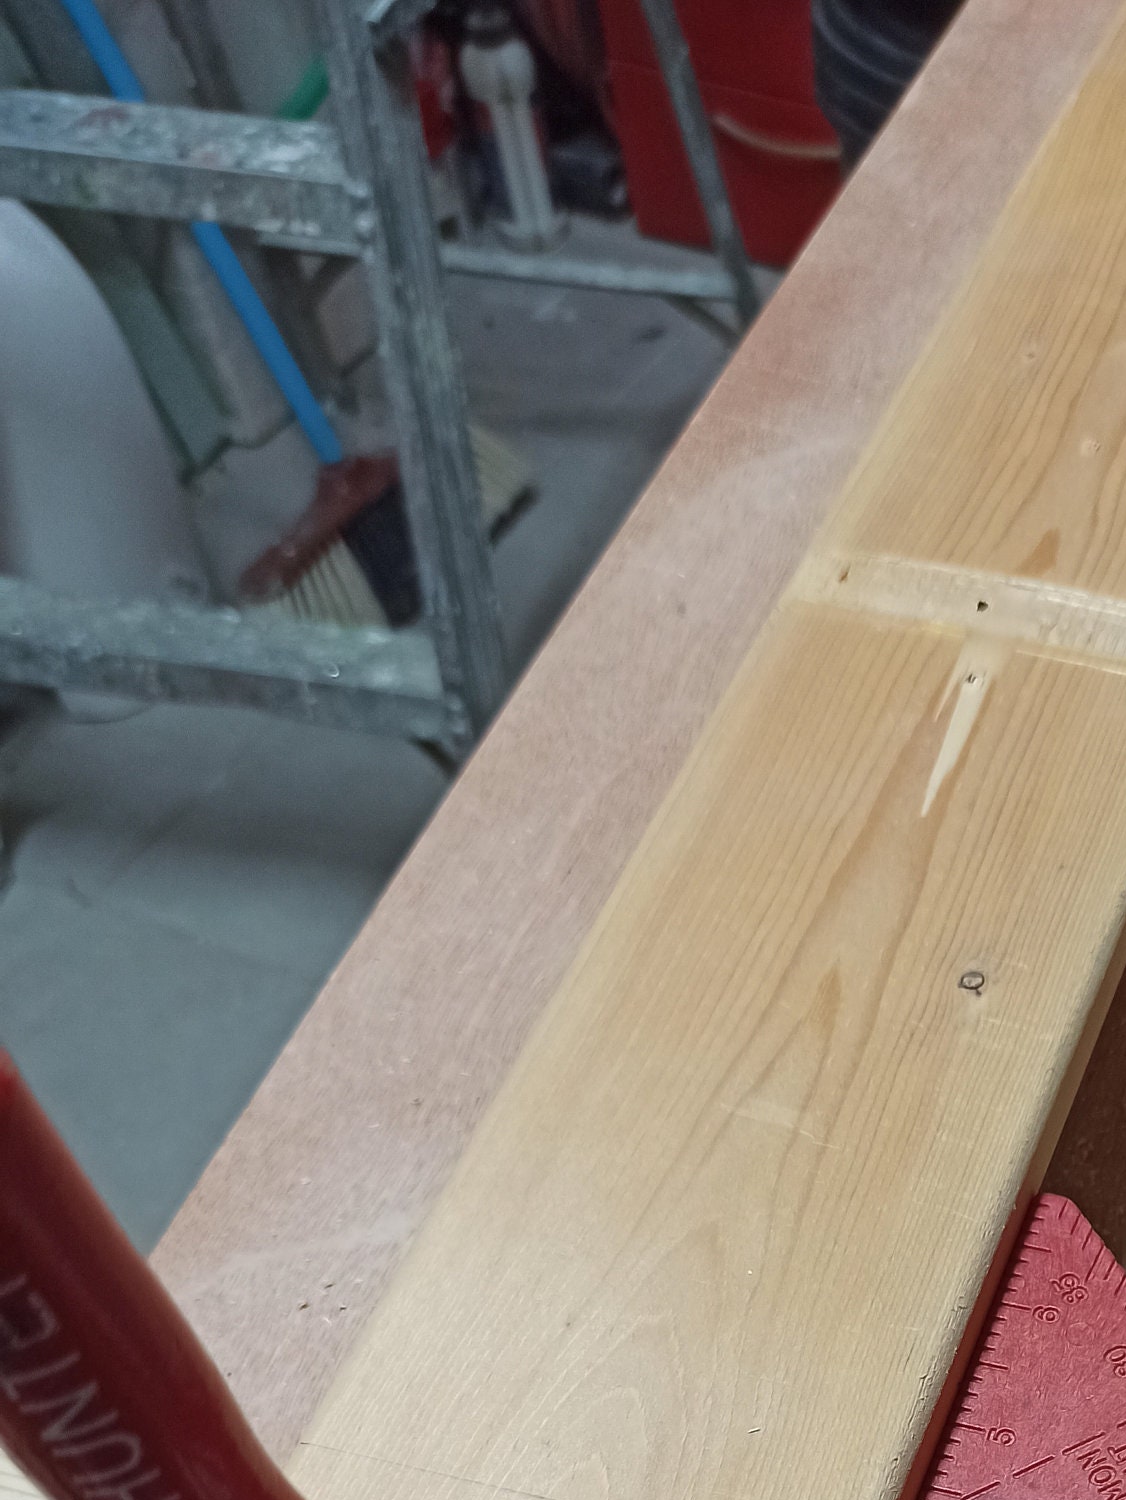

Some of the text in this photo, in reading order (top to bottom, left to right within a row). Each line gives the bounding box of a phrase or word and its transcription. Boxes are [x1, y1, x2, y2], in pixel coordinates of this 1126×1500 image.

[1050, 1273, 1089, 1304] 85
[1032, 1305, 1061, 1322] 6
[986, 1427, 1017, 1447] 5
